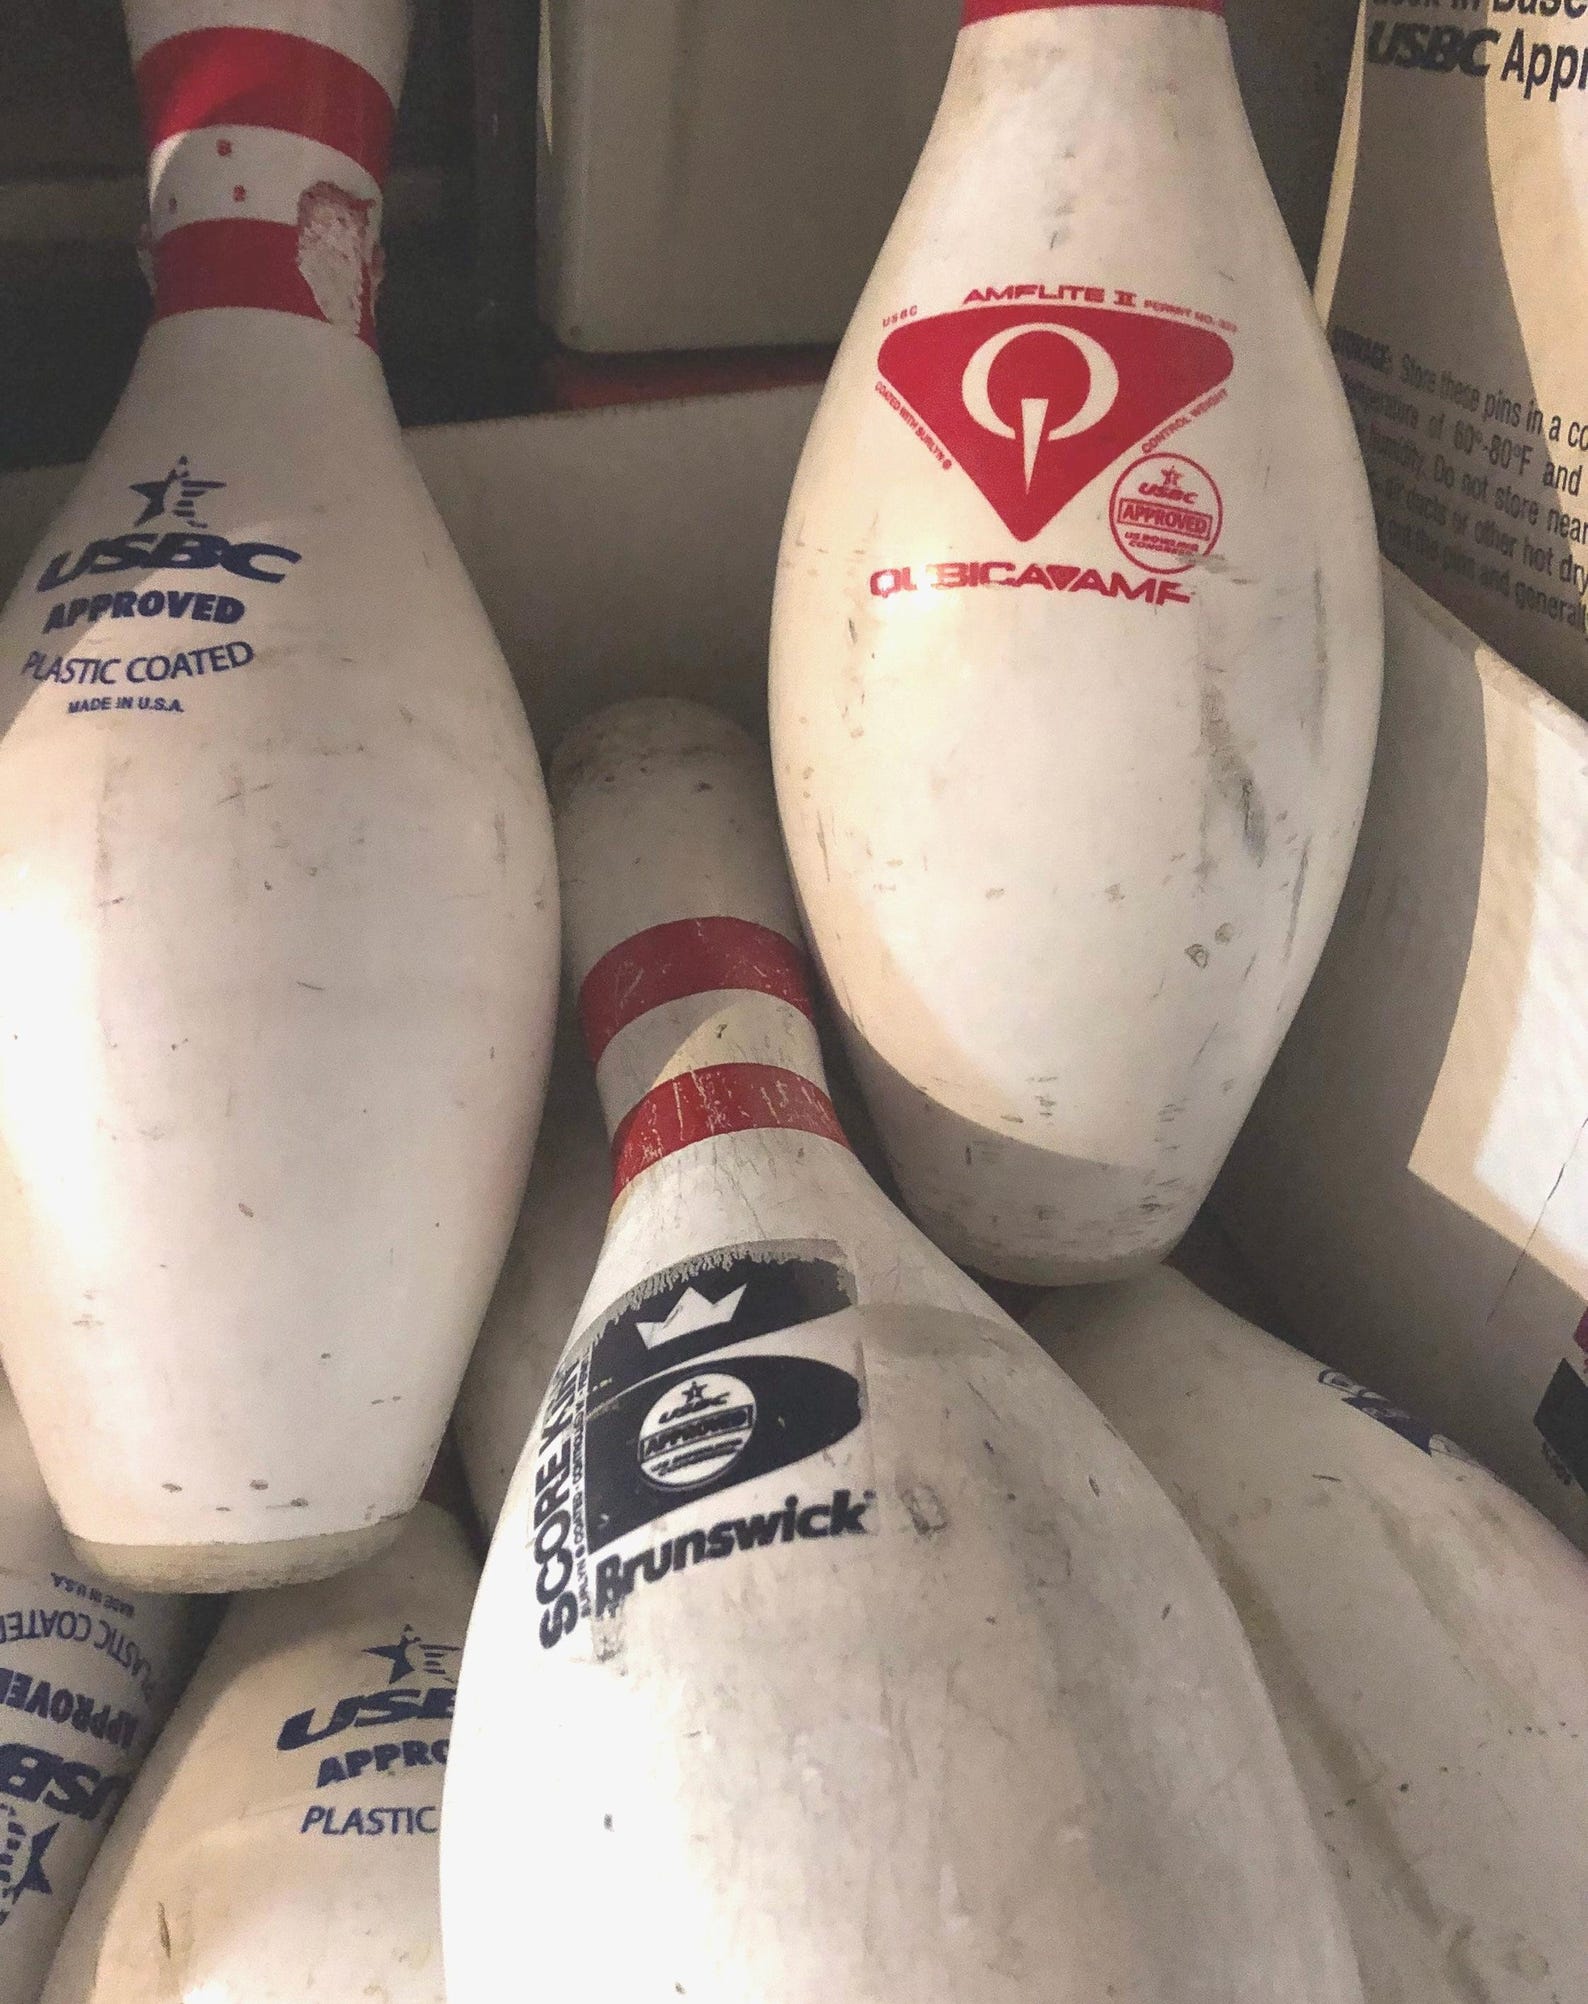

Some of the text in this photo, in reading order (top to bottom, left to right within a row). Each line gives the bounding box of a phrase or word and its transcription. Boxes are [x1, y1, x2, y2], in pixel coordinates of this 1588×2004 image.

[1366, 20, 1501, 77] USBC
[962, 284, 1105, 305] AMFLITE
[1401, 353, 1436, 394] Store
[1440, 369, 1480, 413] these
[1482, 389, 1522, 428] pins
[1526, 399, 1543, 435] in
[1548, 415, 1561, 442] a
[1434, 453, 1455, 489] Do
[1462, 472, 1488, 500] not
[1494, 484, 1539, 526] store
[1543, 461, 1583, 497] and
[1122, 504, 1208, 534] APPROVED
[36, 532, 302, 593] USBC
[1522, 536, 1554, 577] hot
[42, 590, 246, 634] APPROVED
[20, 640, 254, 684] PLASTIC COATED
[67, 697, 111, 713] MADE
[117, 696, 133, 709] IN
[534, 1437, 578, 1649] SCORE
[594, 1488, 867, 1618] Brunswick
[0, 1609, 92, 1645] COATE
[300, 1805, 438, 1835] PLASTIC
